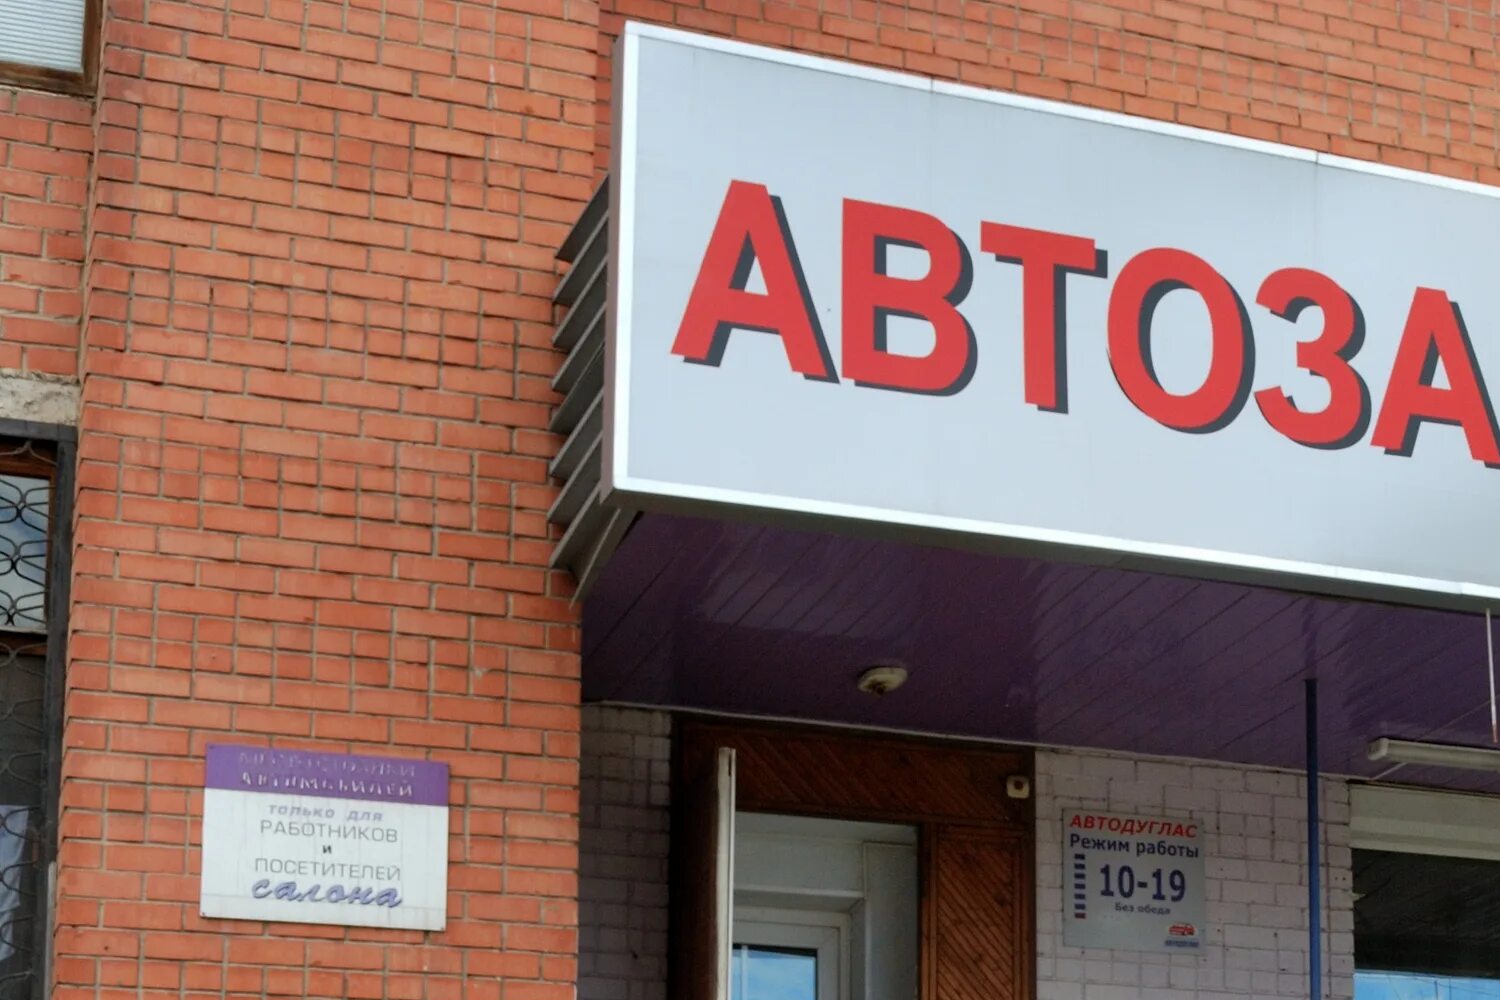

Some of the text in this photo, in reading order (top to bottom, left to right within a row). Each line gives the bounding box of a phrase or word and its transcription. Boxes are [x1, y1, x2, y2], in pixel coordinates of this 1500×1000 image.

[260, 819, 398, 843] РАБОТНИКОВ
[1070, 815, 1198, 838] АВТОДУГЛАС
[1070, 833, 1199, 858] Режим работы
[254, 858, 401, 881] ПОСЕТИТЕЛЕЙ
[251, 879, 403, 908] салона
[1100, 864, 1185, 902] 10-19
